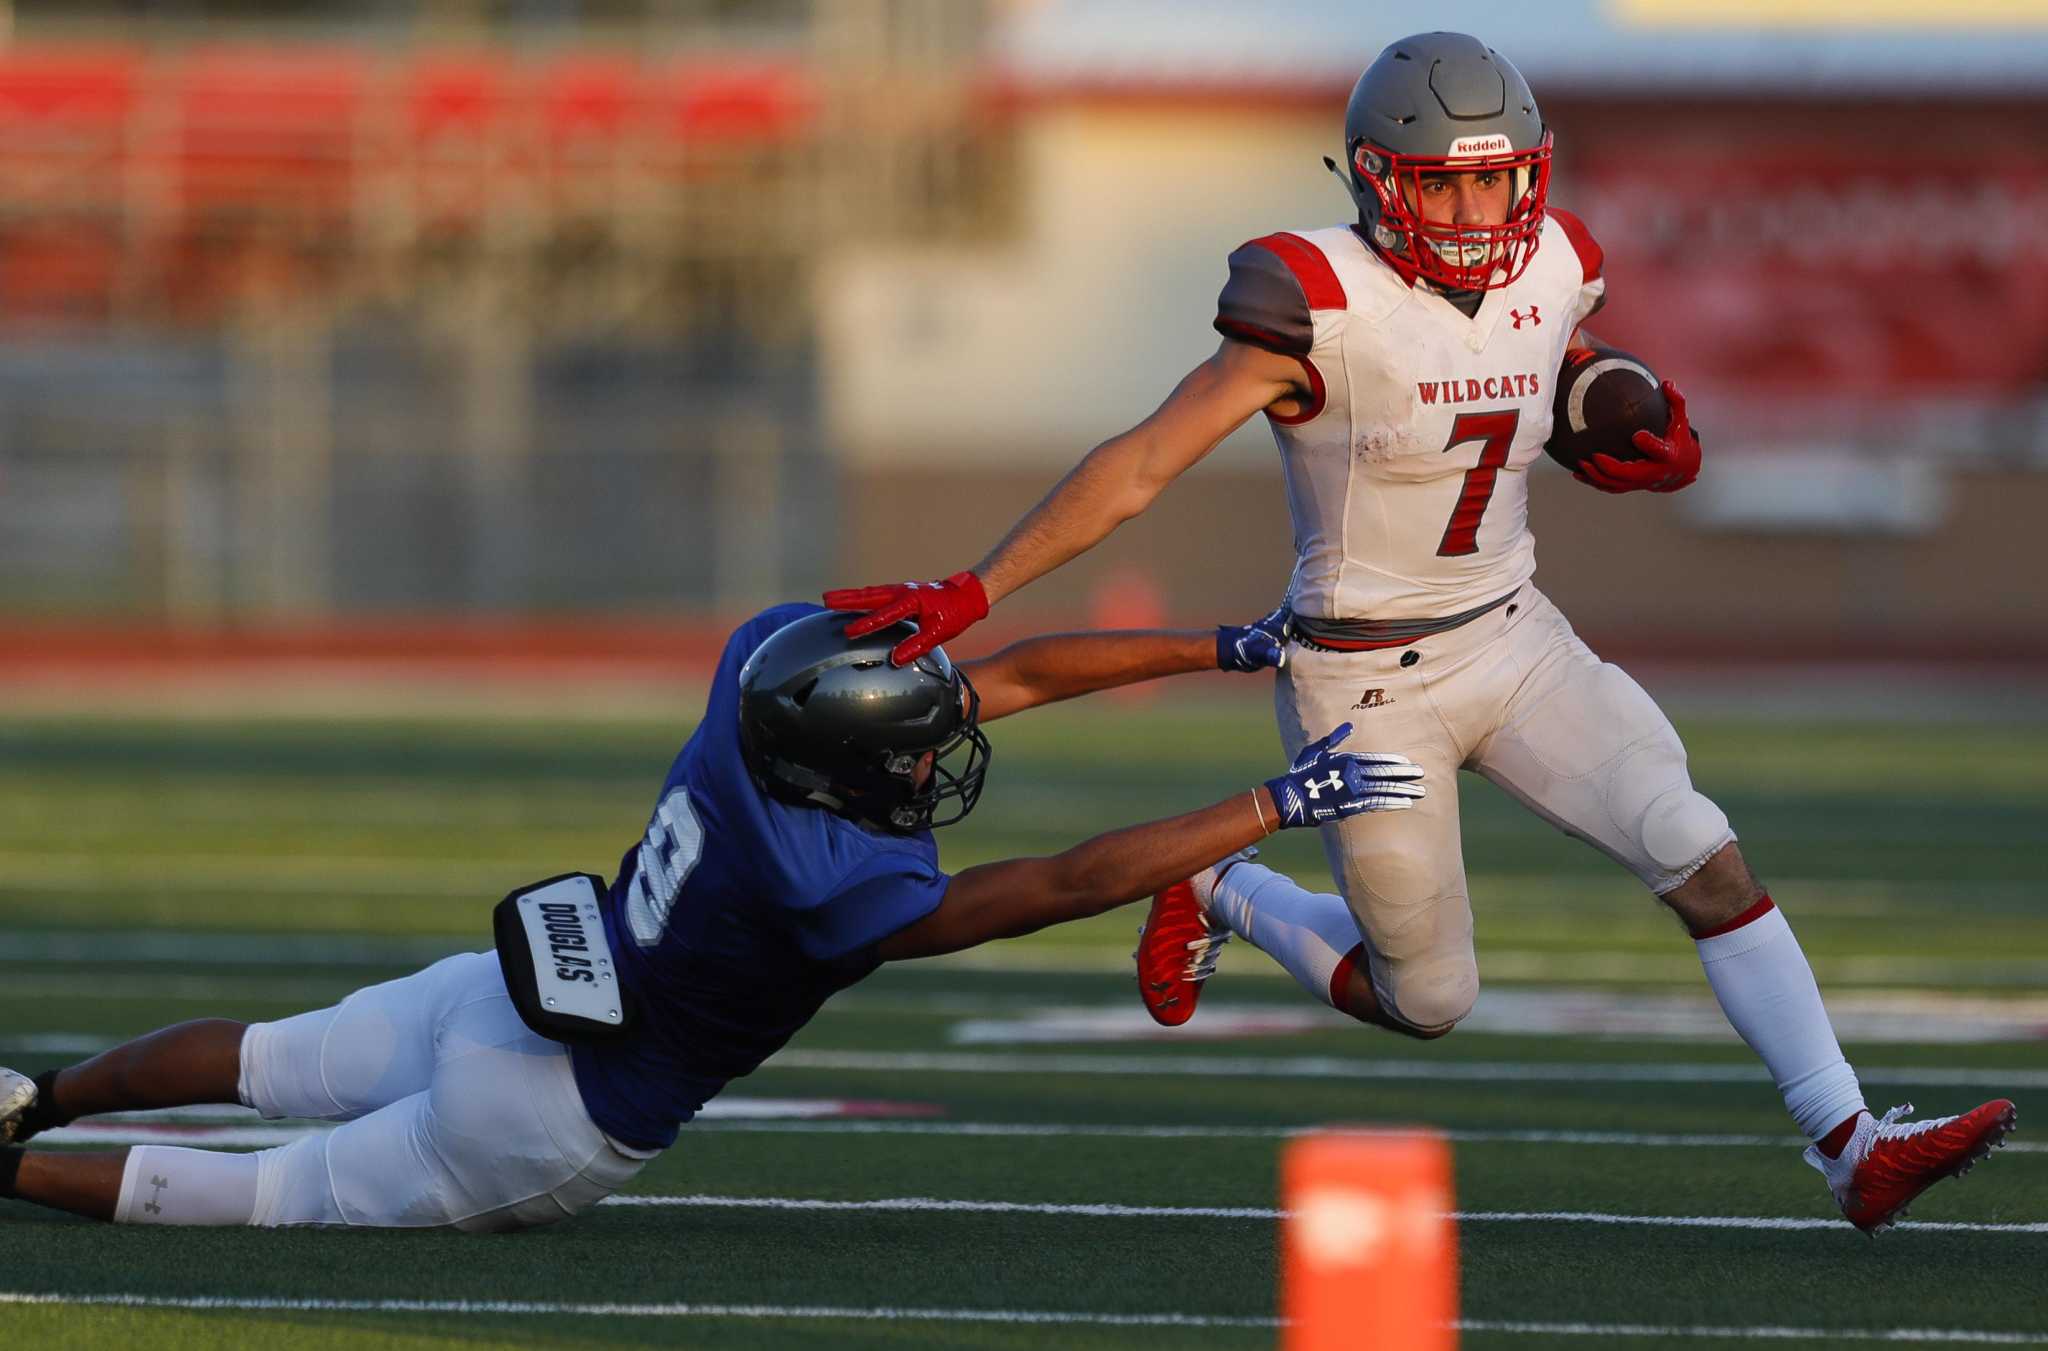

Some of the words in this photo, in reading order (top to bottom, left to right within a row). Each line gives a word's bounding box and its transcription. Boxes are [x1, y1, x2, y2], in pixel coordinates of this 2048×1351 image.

[1457, 139, 1505, 152] Riddell
[1417, 373, 1539, 405] WILDCATS
[1436, 408, 1520, 556] 7
[538, 902, 594, 982] DOUGLAS
